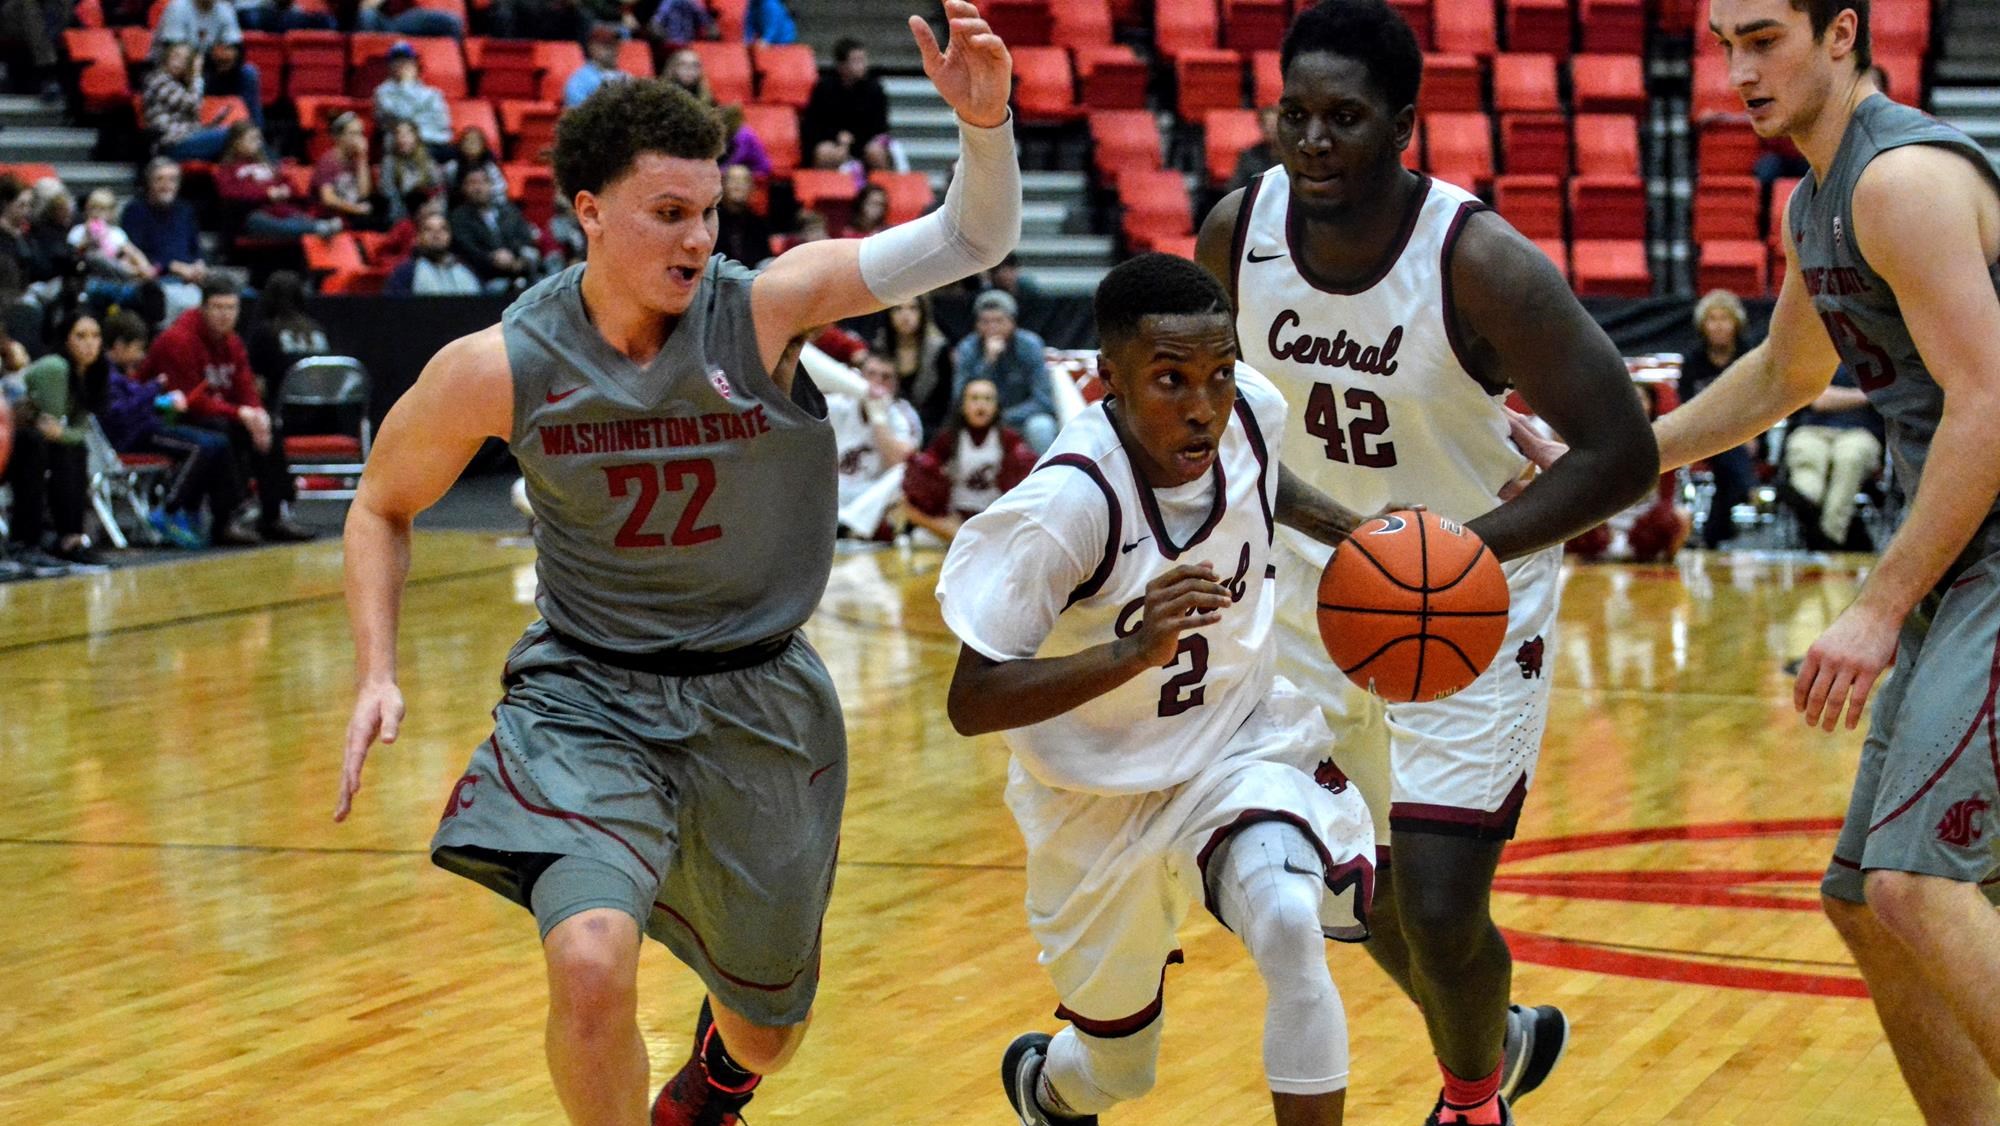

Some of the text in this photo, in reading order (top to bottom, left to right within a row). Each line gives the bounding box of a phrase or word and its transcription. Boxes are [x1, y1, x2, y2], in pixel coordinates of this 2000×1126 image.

[1268, 309, 1404, 376] Central
[539, 403, 771, 455] WASHINGTON STATE
[1304, 381, 1398, 468] 42
[601, 458, 722, 547] 22
[1158, 632, 1210, 717] 2
